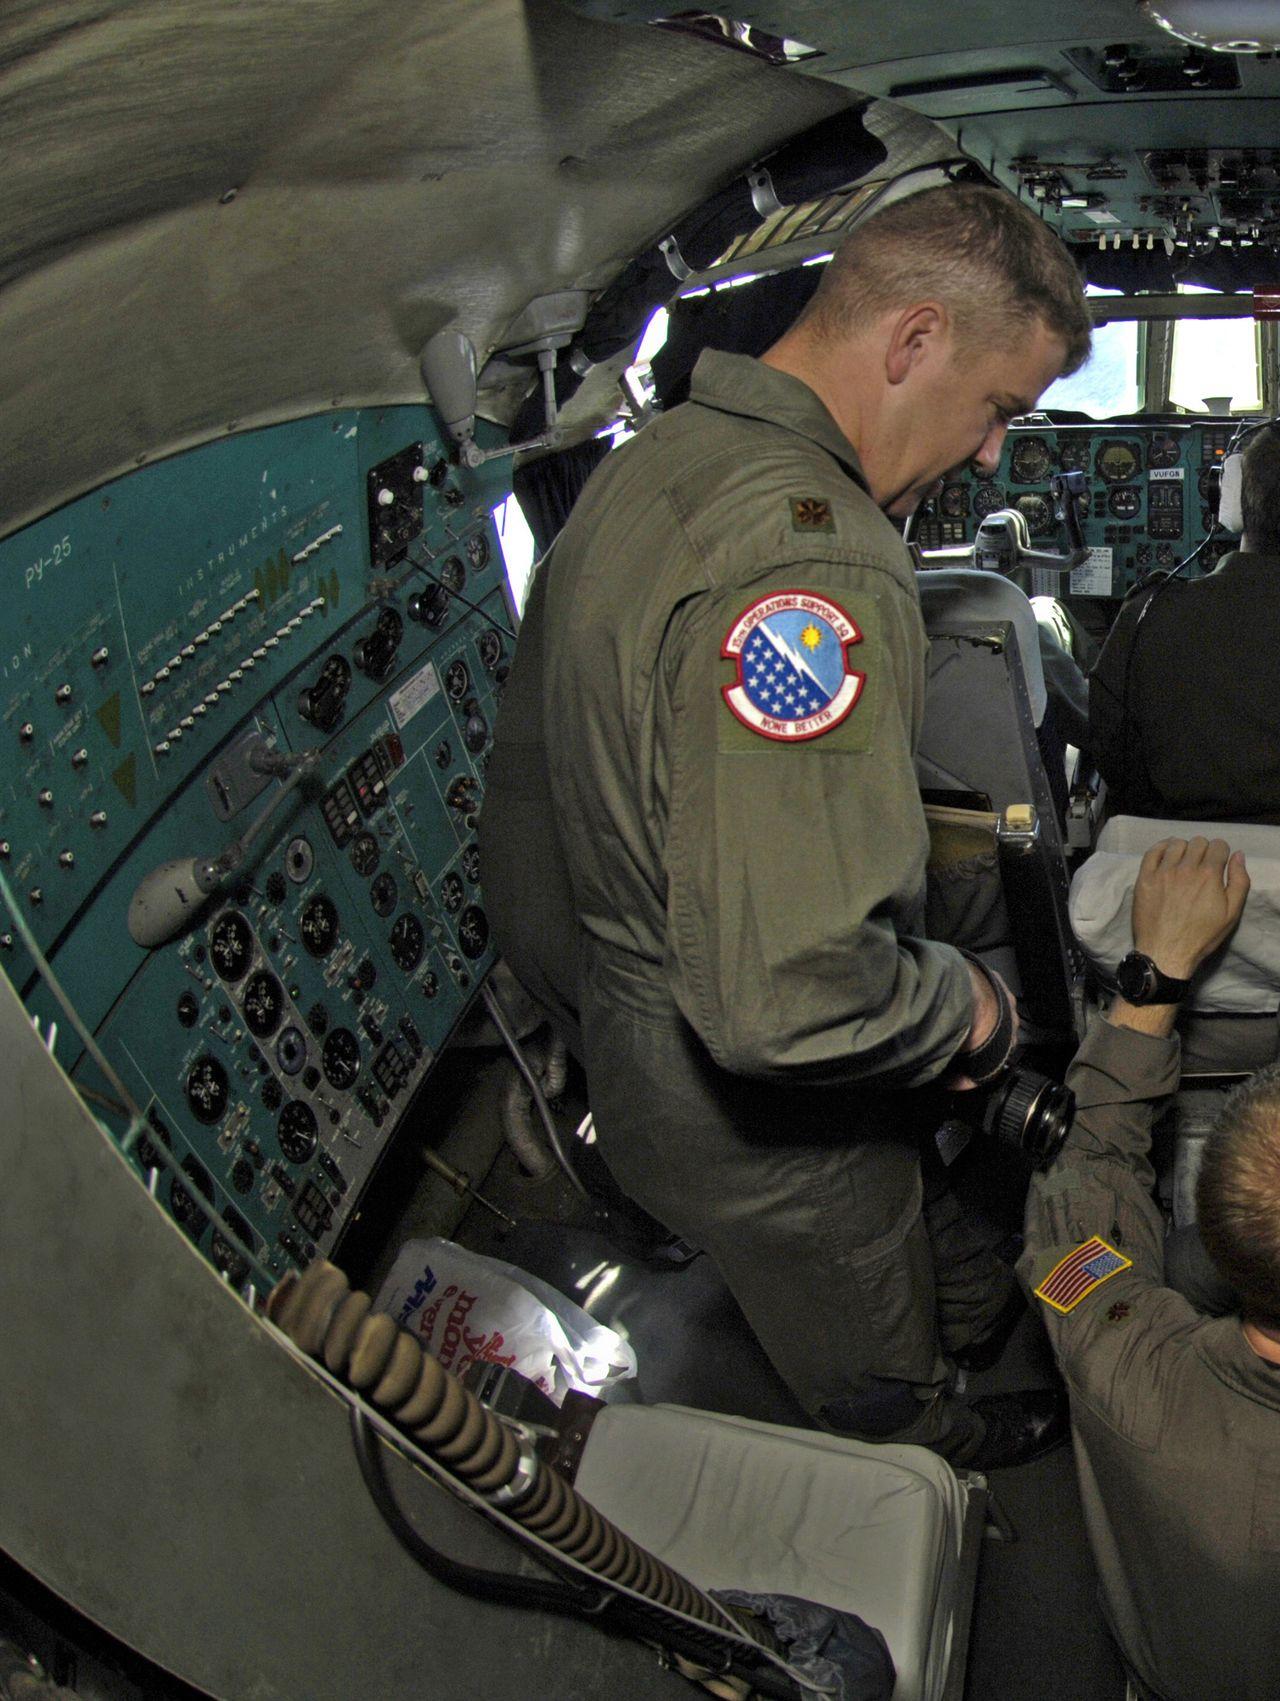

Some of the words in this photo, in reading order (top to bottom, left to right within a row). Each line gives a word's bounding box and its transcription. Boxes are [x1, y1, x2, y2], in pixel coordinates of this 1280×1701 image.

[178, 505, 288, 597] INSTRUMENTS
[744, 597, 798, 628] OPERATIONS
[800, 599, 840, 624] SUPPORT
[761, 716, 788, 734] NONE
[794, 711, 833, 733] BETTER
